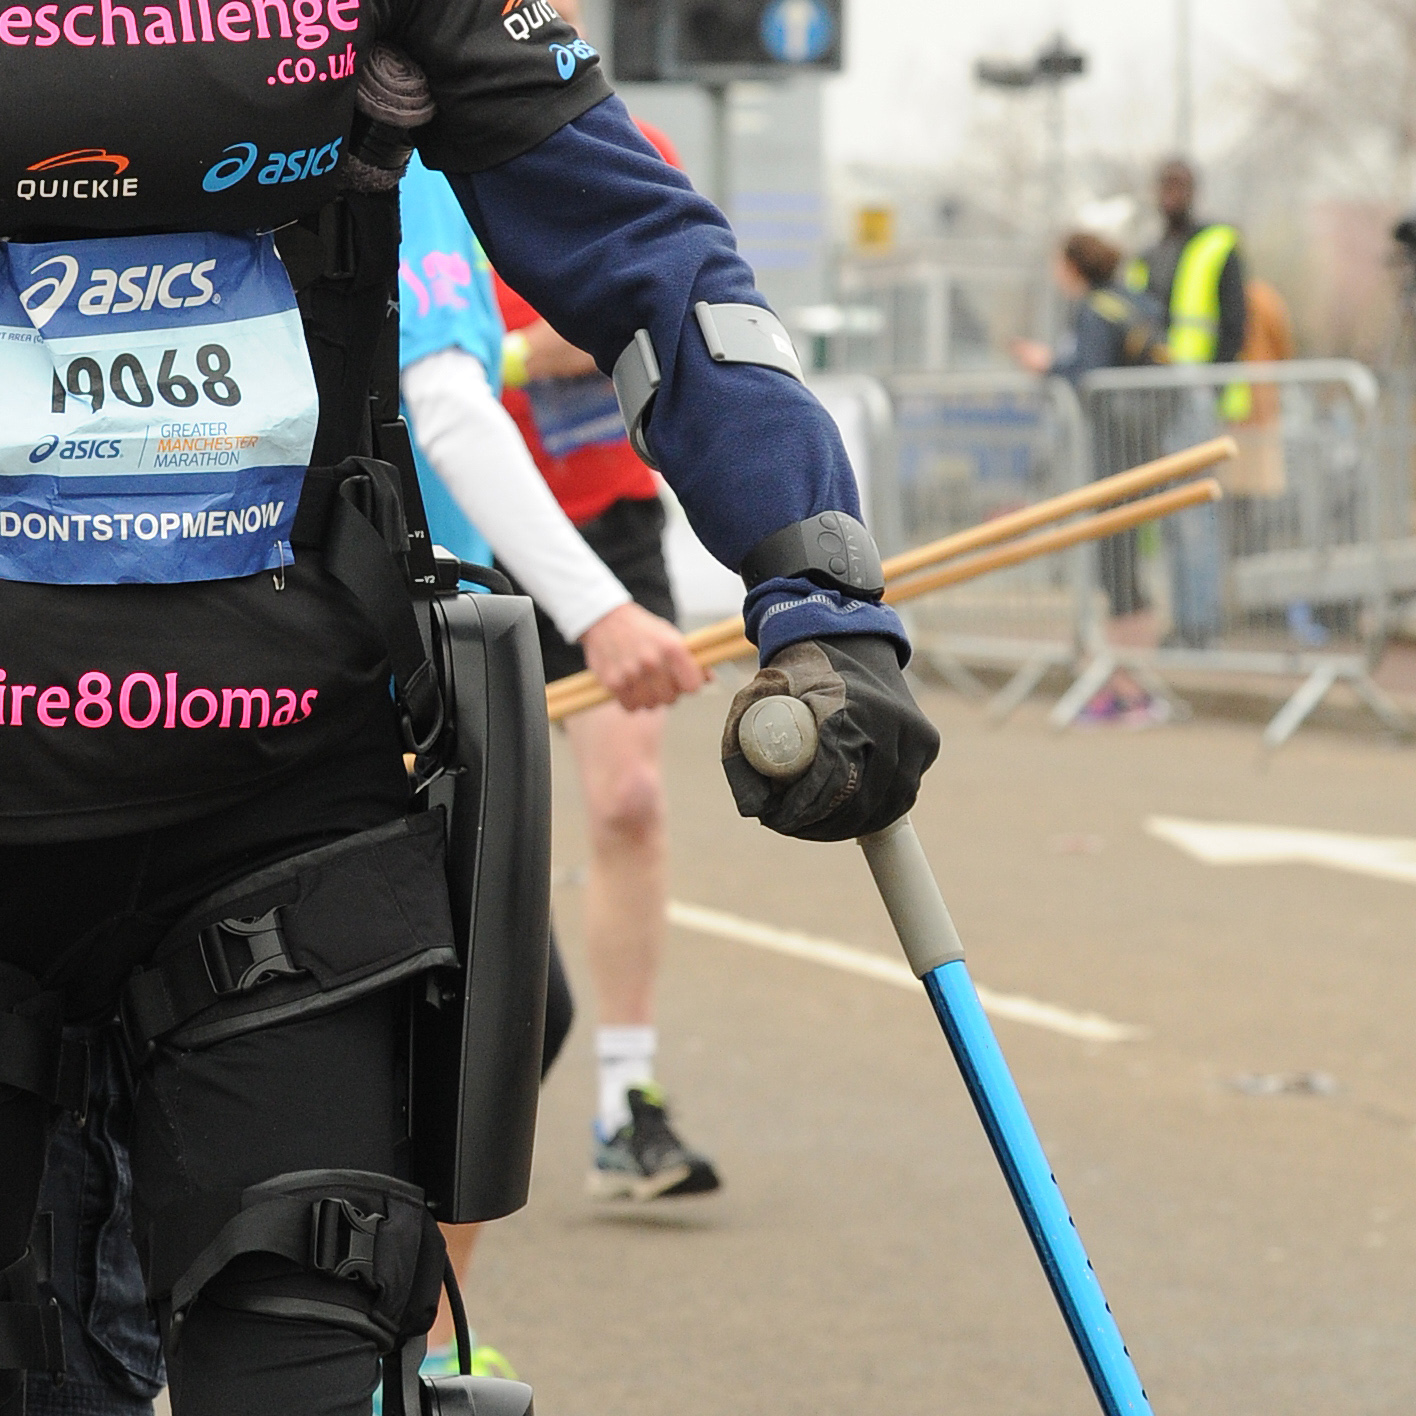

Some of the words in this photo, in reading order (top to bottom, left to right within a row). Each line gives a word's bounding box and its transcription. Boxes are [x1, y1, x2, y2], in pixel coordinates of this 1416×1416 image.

[267, 43, 358, 86] .co.uk
[16, 177, 139, 201] QUICKIE
[8, 332, 32, 342] AREA
[160, 422, 228, 438] GREATER
[157, 435, 259, 452] MANCHESTER
[153, 451, 241, 468] MARATHON
